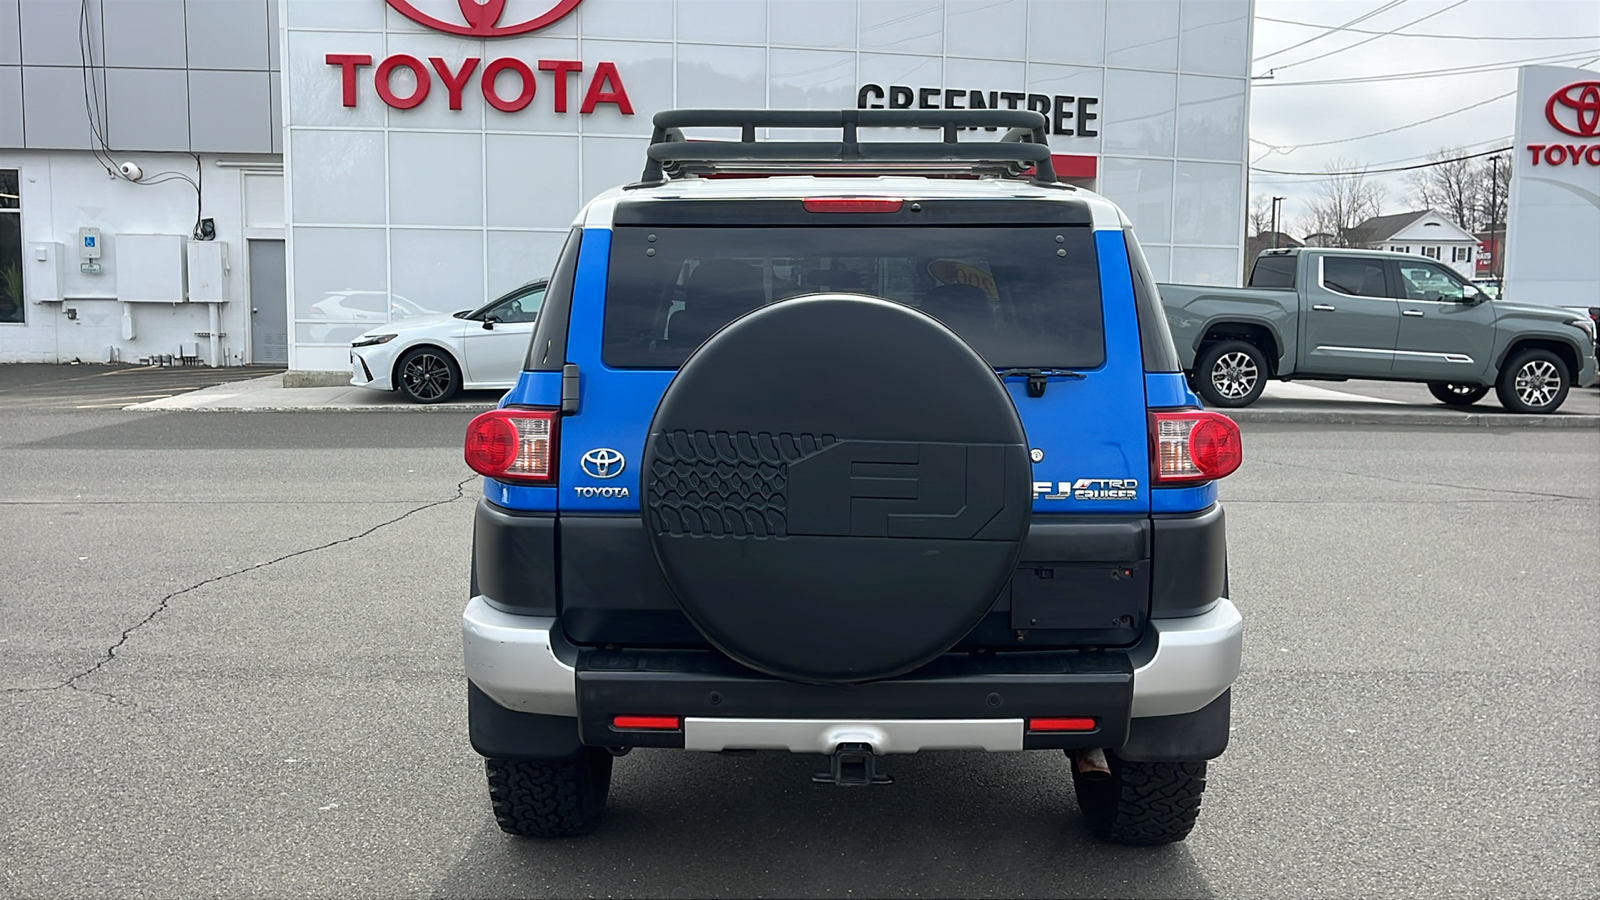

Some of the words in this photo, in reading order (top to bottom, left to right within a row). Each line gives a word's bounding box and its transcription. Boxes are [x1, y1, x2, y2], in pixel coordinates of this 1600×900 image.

[325, 53, 635, 115] TOYOTA
[1032, 481, 1072, 500] FJ
[1097, 479, 1139, 490] TRD
[574, 486, 630, 498] TOYOTA
[1074, 489, 1138, 500] CRUISER
